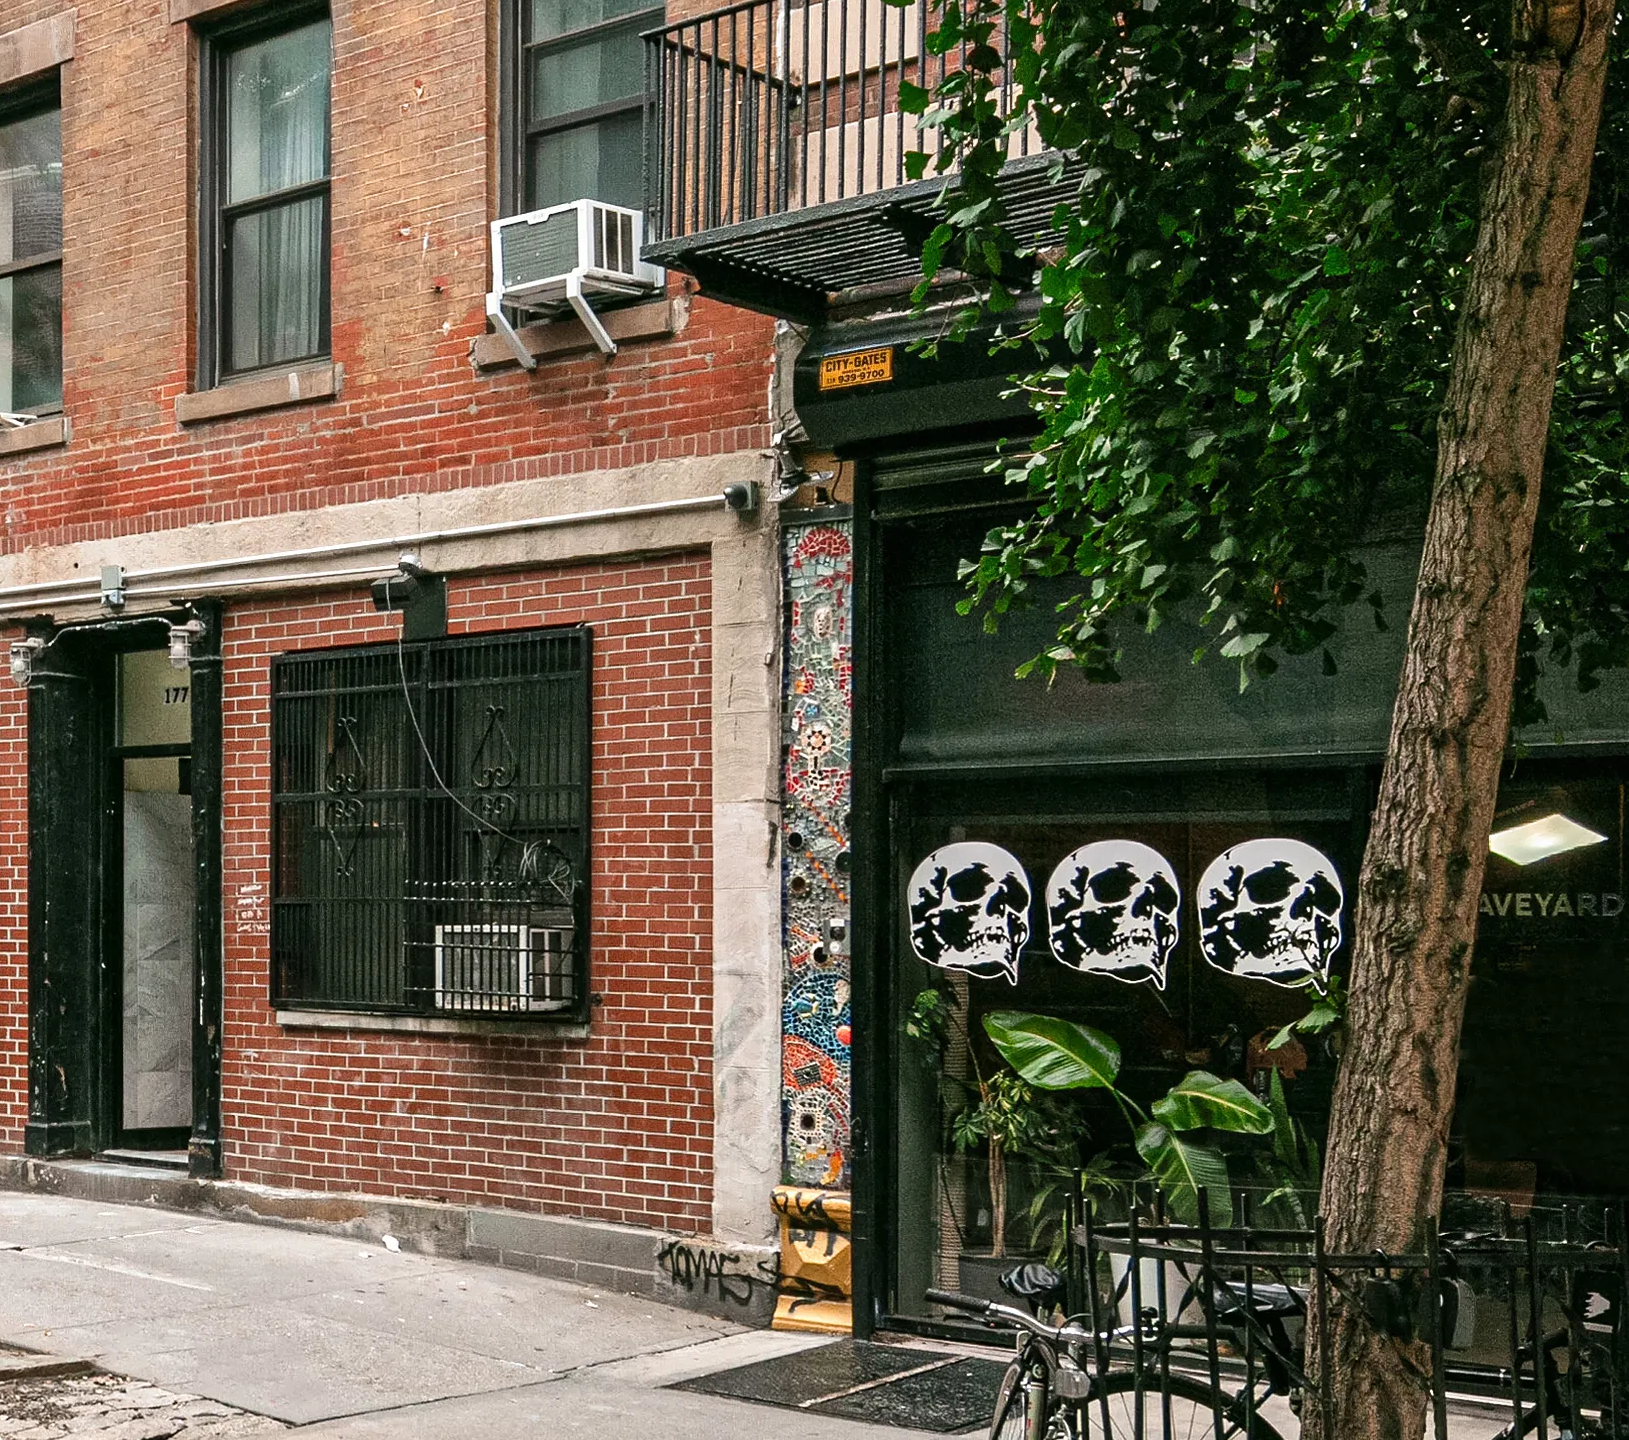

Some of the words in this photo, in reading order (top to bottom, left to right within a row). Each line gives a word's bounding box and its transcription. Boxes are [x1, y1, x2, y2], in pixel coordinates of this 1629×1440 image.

[825, 352, 887, 372] CITY-GATES
[838, 369, 885, 383] 939-9700
[165, 686, 189, 703] 177
